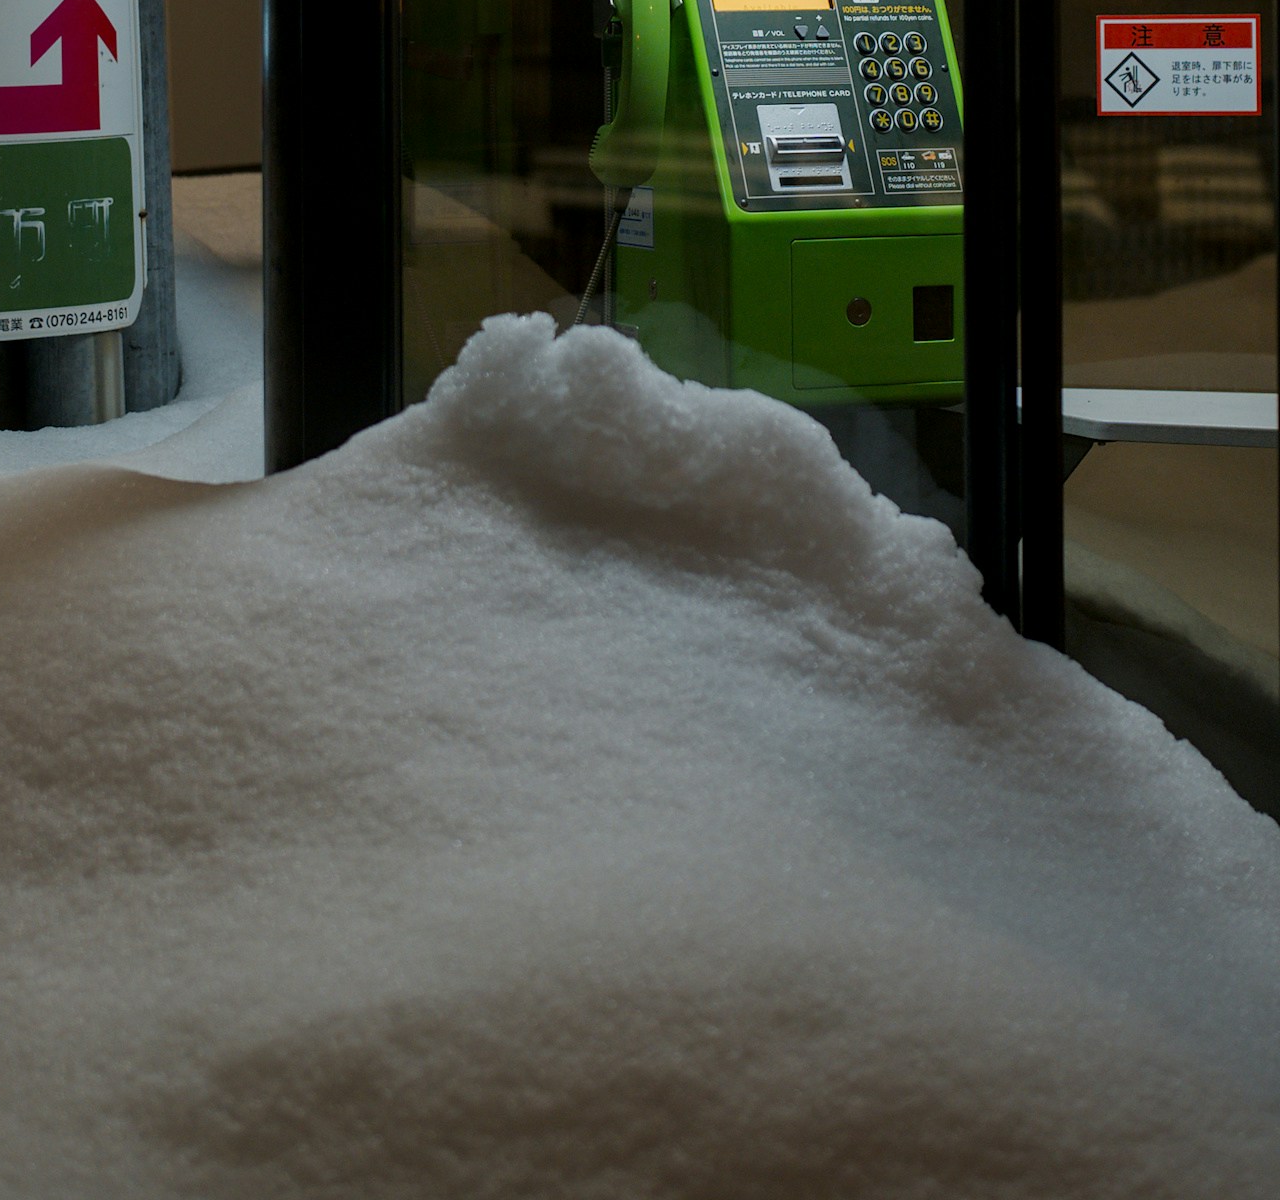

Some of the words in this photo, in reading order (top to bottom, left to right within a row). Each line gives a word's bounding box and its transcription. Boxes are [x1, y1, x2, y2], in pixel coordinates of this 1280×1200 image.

[886, 36, 898, 50] 2
[911, 36, 922, 50] 3
[867, 62, 877, 76] 4
[891, 61, 903, 76] 5
[915, 60, 928, 75] 6
[1171, 60, 1253, 71] 退室時、扉下部に
[1171, 74, 1253, 85] 足をはさむ事があ
[732, 92, 778, 100] テレホンカード
[871, 87, 883, 102] 7
[896, 86, 909, 102] 8
[921, 86, 932, 101] 9
[1173, 87, 1207, 96] ります。
[902, 112, 914, 127] 0
[880, 157, 897, 166] SOS
[903, 162, 916, 170] 110
[46, 307, 128, 329] (076)244-8161
